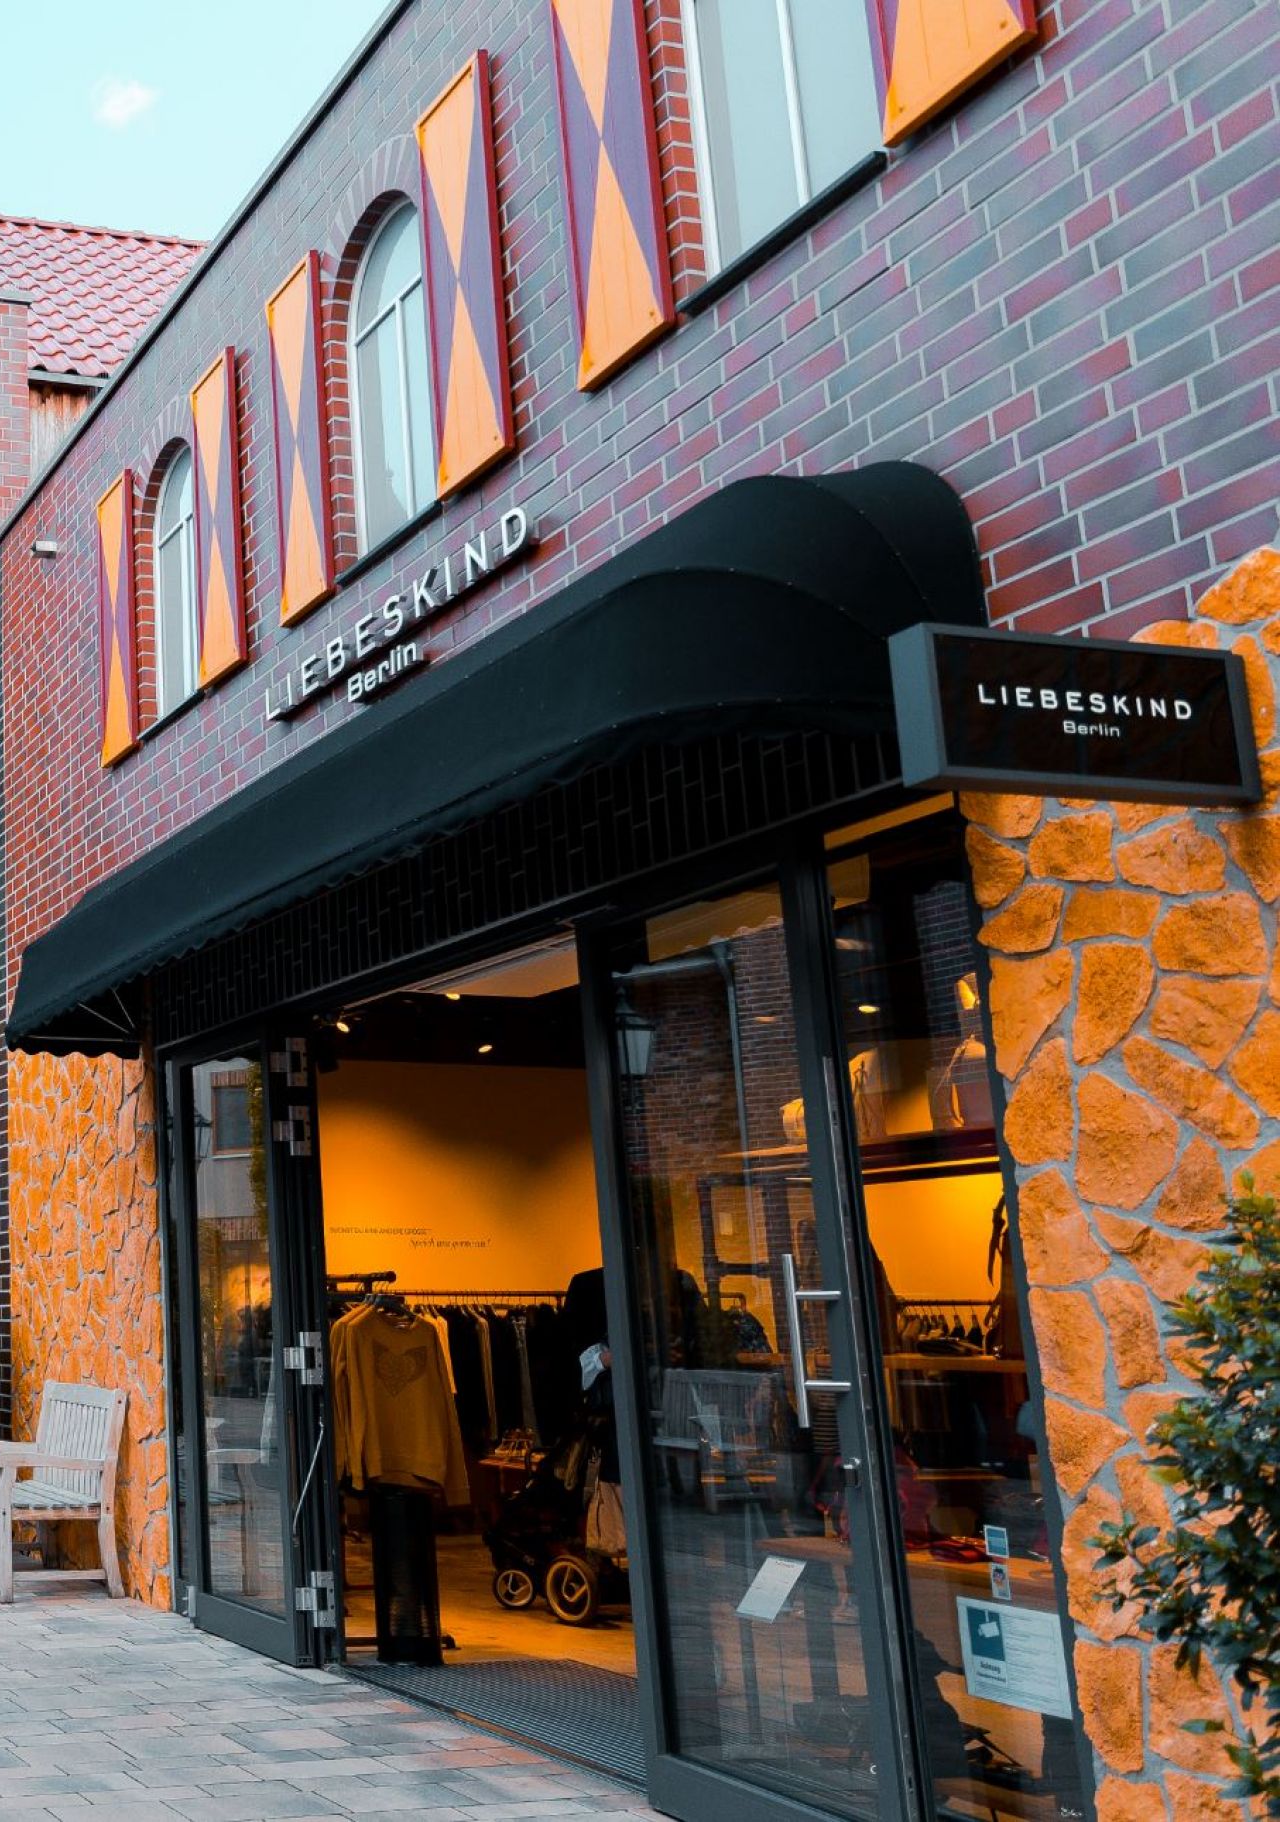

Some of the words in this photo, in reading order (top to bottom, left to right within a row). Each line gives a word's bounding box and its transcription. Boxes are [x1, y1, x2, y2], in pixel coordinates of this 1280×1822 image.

[265, 506, 530, 721] LIEBESKIND
[346, 641, 419, 703] Berlin
[977, 683, 1193, 721] LIEBESKIND
[1062, 719, 1121, 738] Berlin
